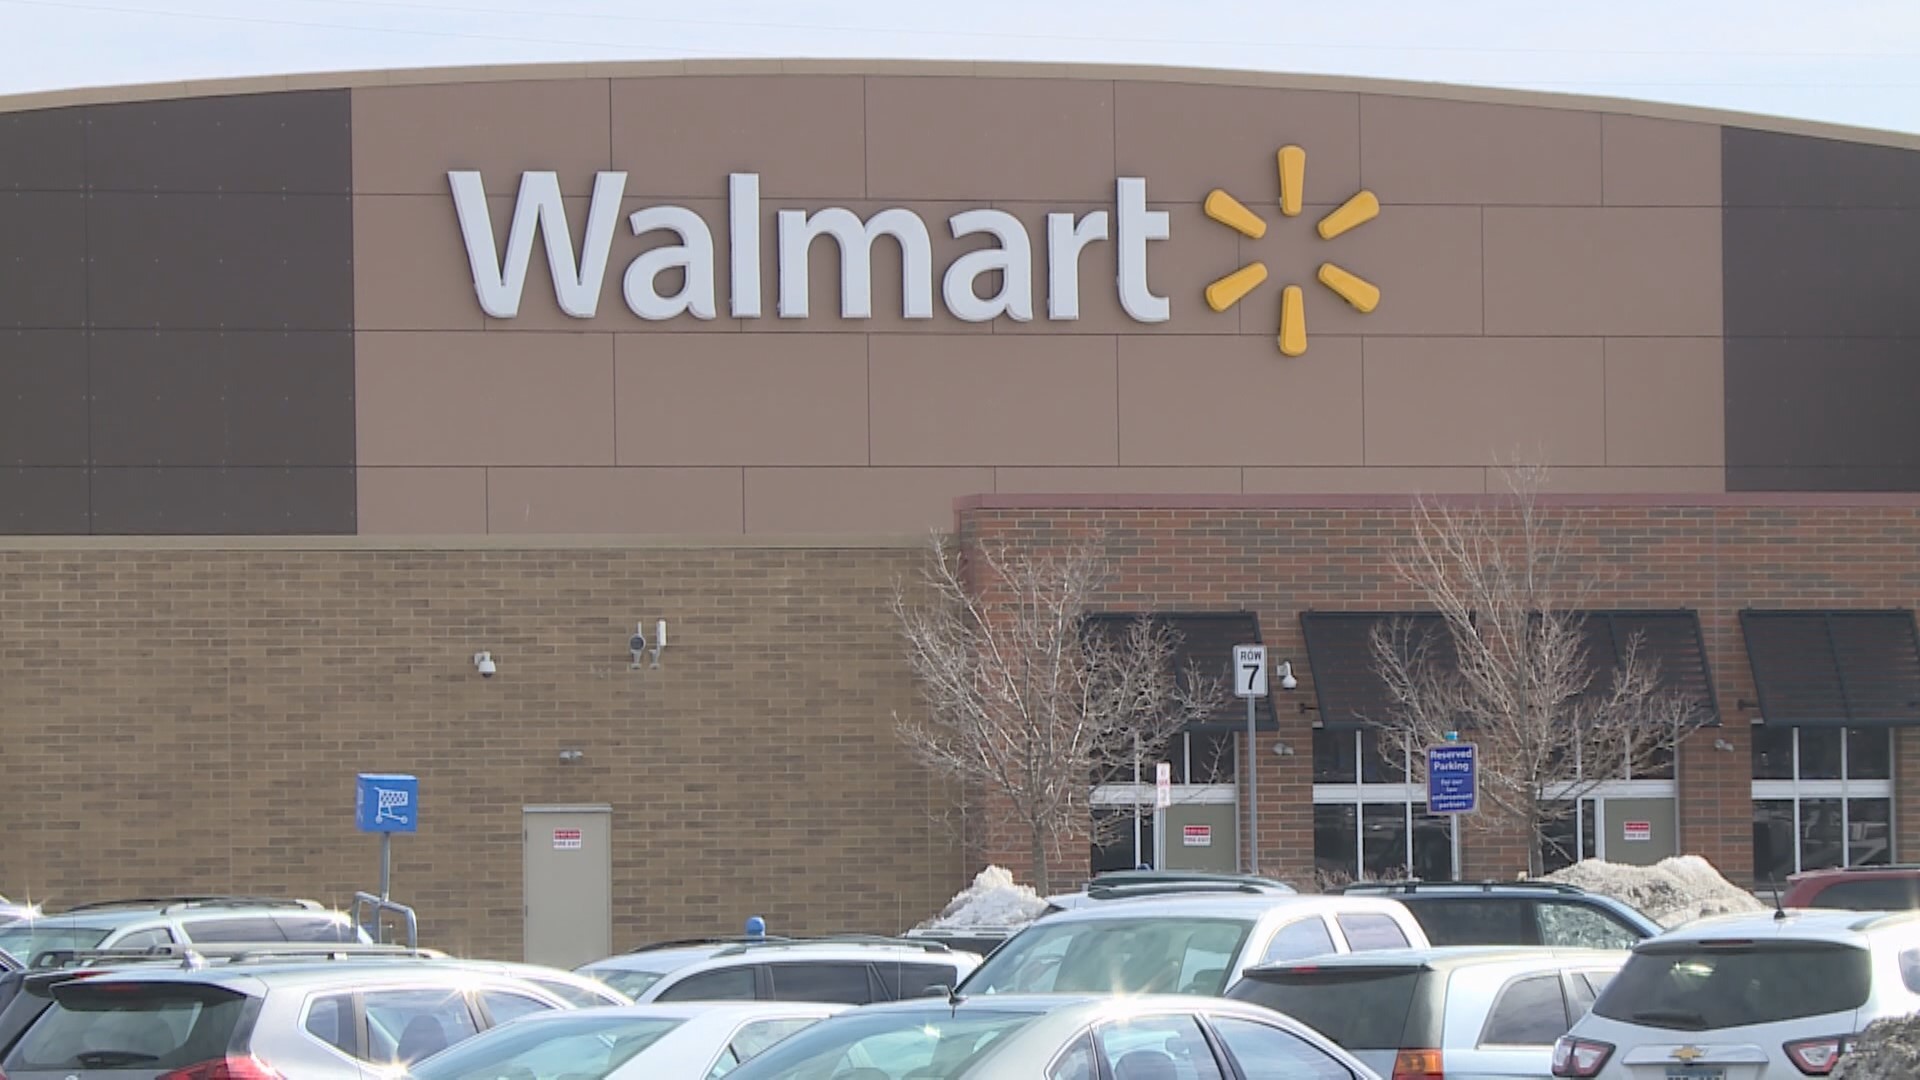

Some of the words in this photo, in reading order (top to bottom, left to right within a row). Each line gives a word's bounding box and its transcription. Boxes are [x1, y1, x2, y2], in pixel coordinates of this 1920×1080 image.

[447, 169, 1171, 323] Walmart
[1240, 651, 1262, 660] ROW
[1243, 664, 1260, 690] 7
[1430, 750, 1472, 759] Reserved
[1434, 761, 1469, 772] Parking
